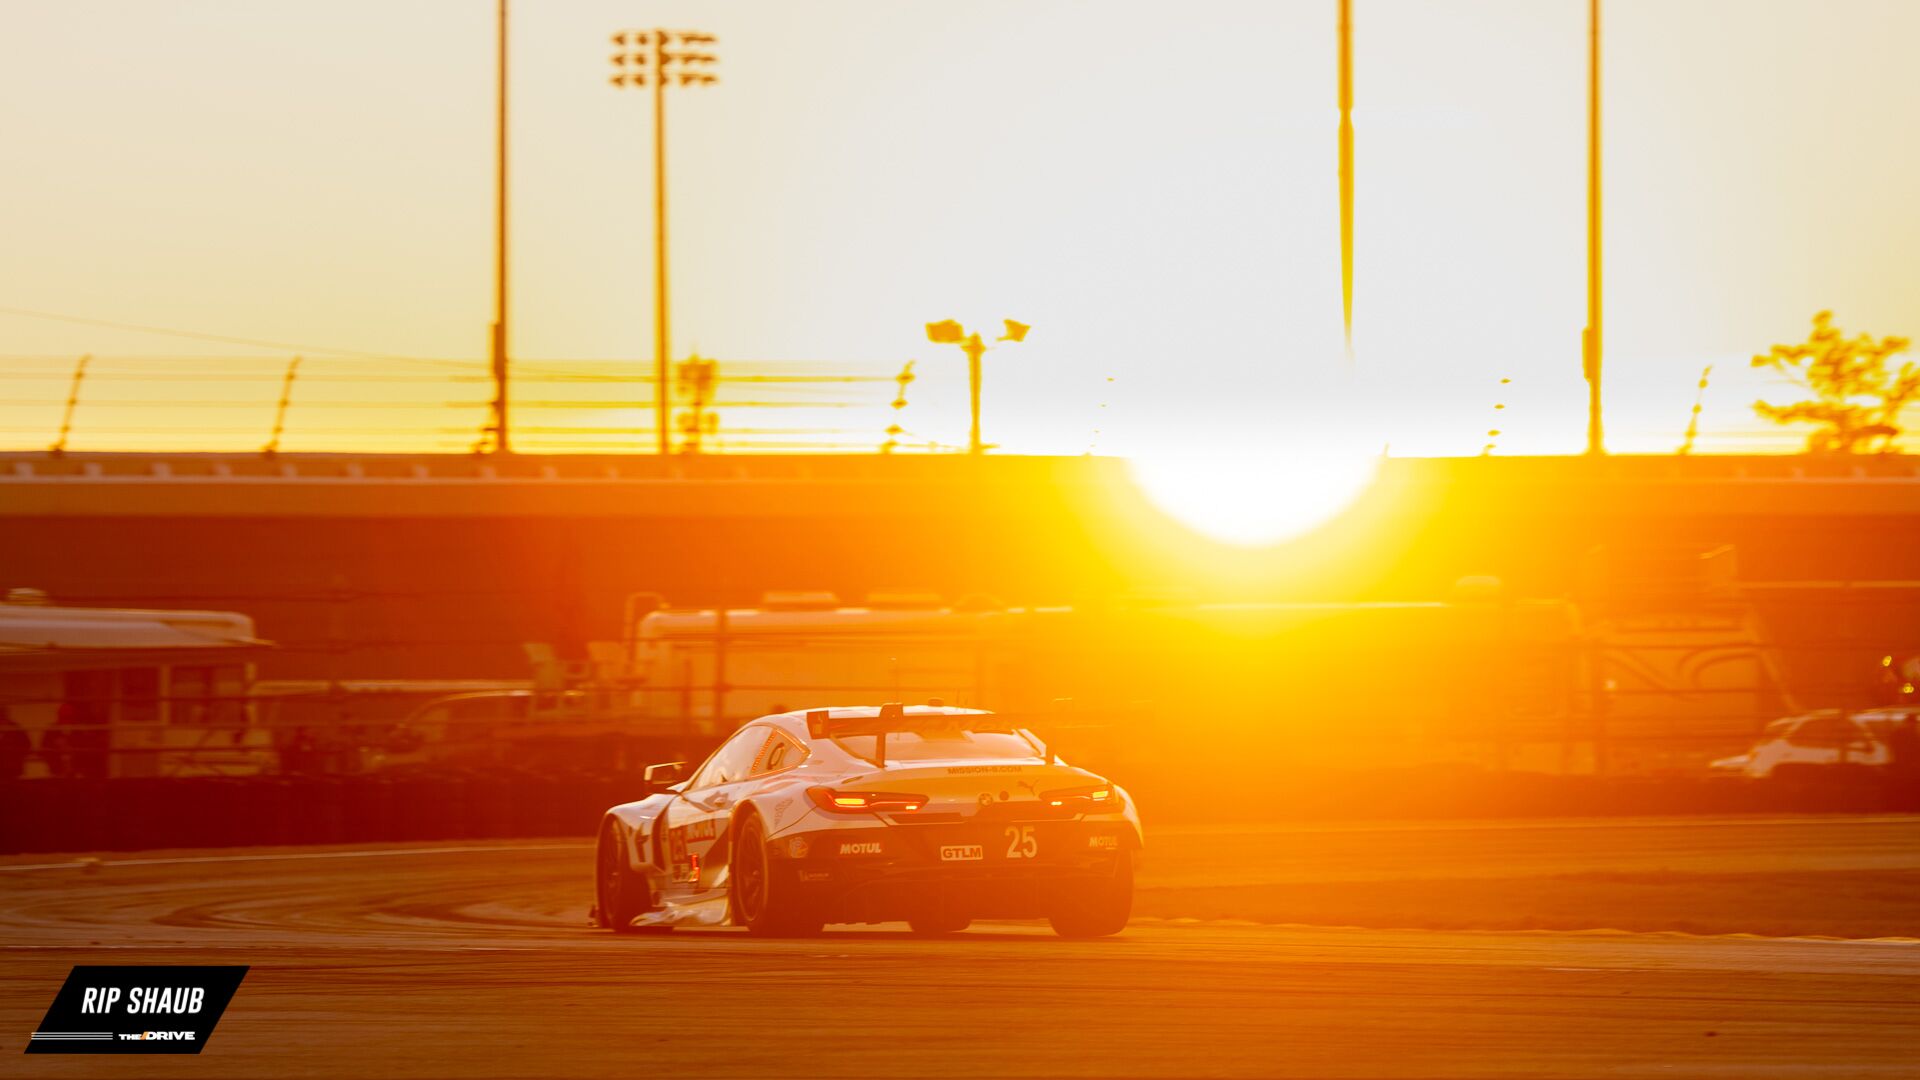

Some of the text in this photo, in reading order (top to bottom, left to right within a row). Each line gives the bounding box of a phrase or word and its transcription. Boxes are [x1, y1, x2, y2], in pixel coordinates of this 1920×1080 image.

[1004, 825, 1038, 858] 25
[1088, 836, 1118, 848] MOTUL
[840, 843, 882, 855] MOTUL
[942, 847, 981, 858] GTLM
